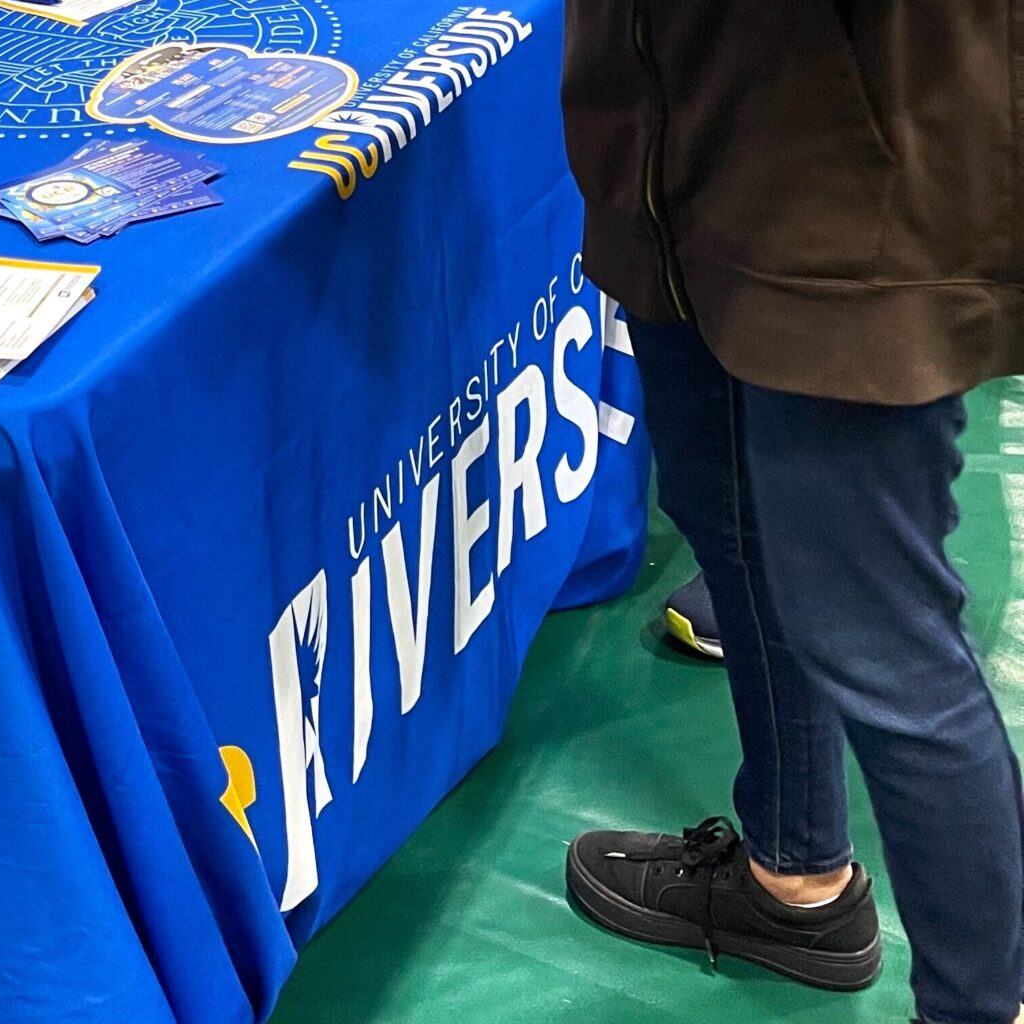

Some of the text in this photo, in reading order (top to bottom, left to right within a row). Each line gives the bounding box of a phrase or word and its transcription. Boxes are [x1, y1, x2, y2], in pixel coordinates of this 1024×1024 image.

[312, 6, 533, 164] RIVERSIDE
[344, 59, 405, 108] UNIVERSITY
[398, 47, 418, 59] OF
[412, 5, 474, 48] CALIFORNIA
[348, 276, 558, 559] UNIVERSITY OF
